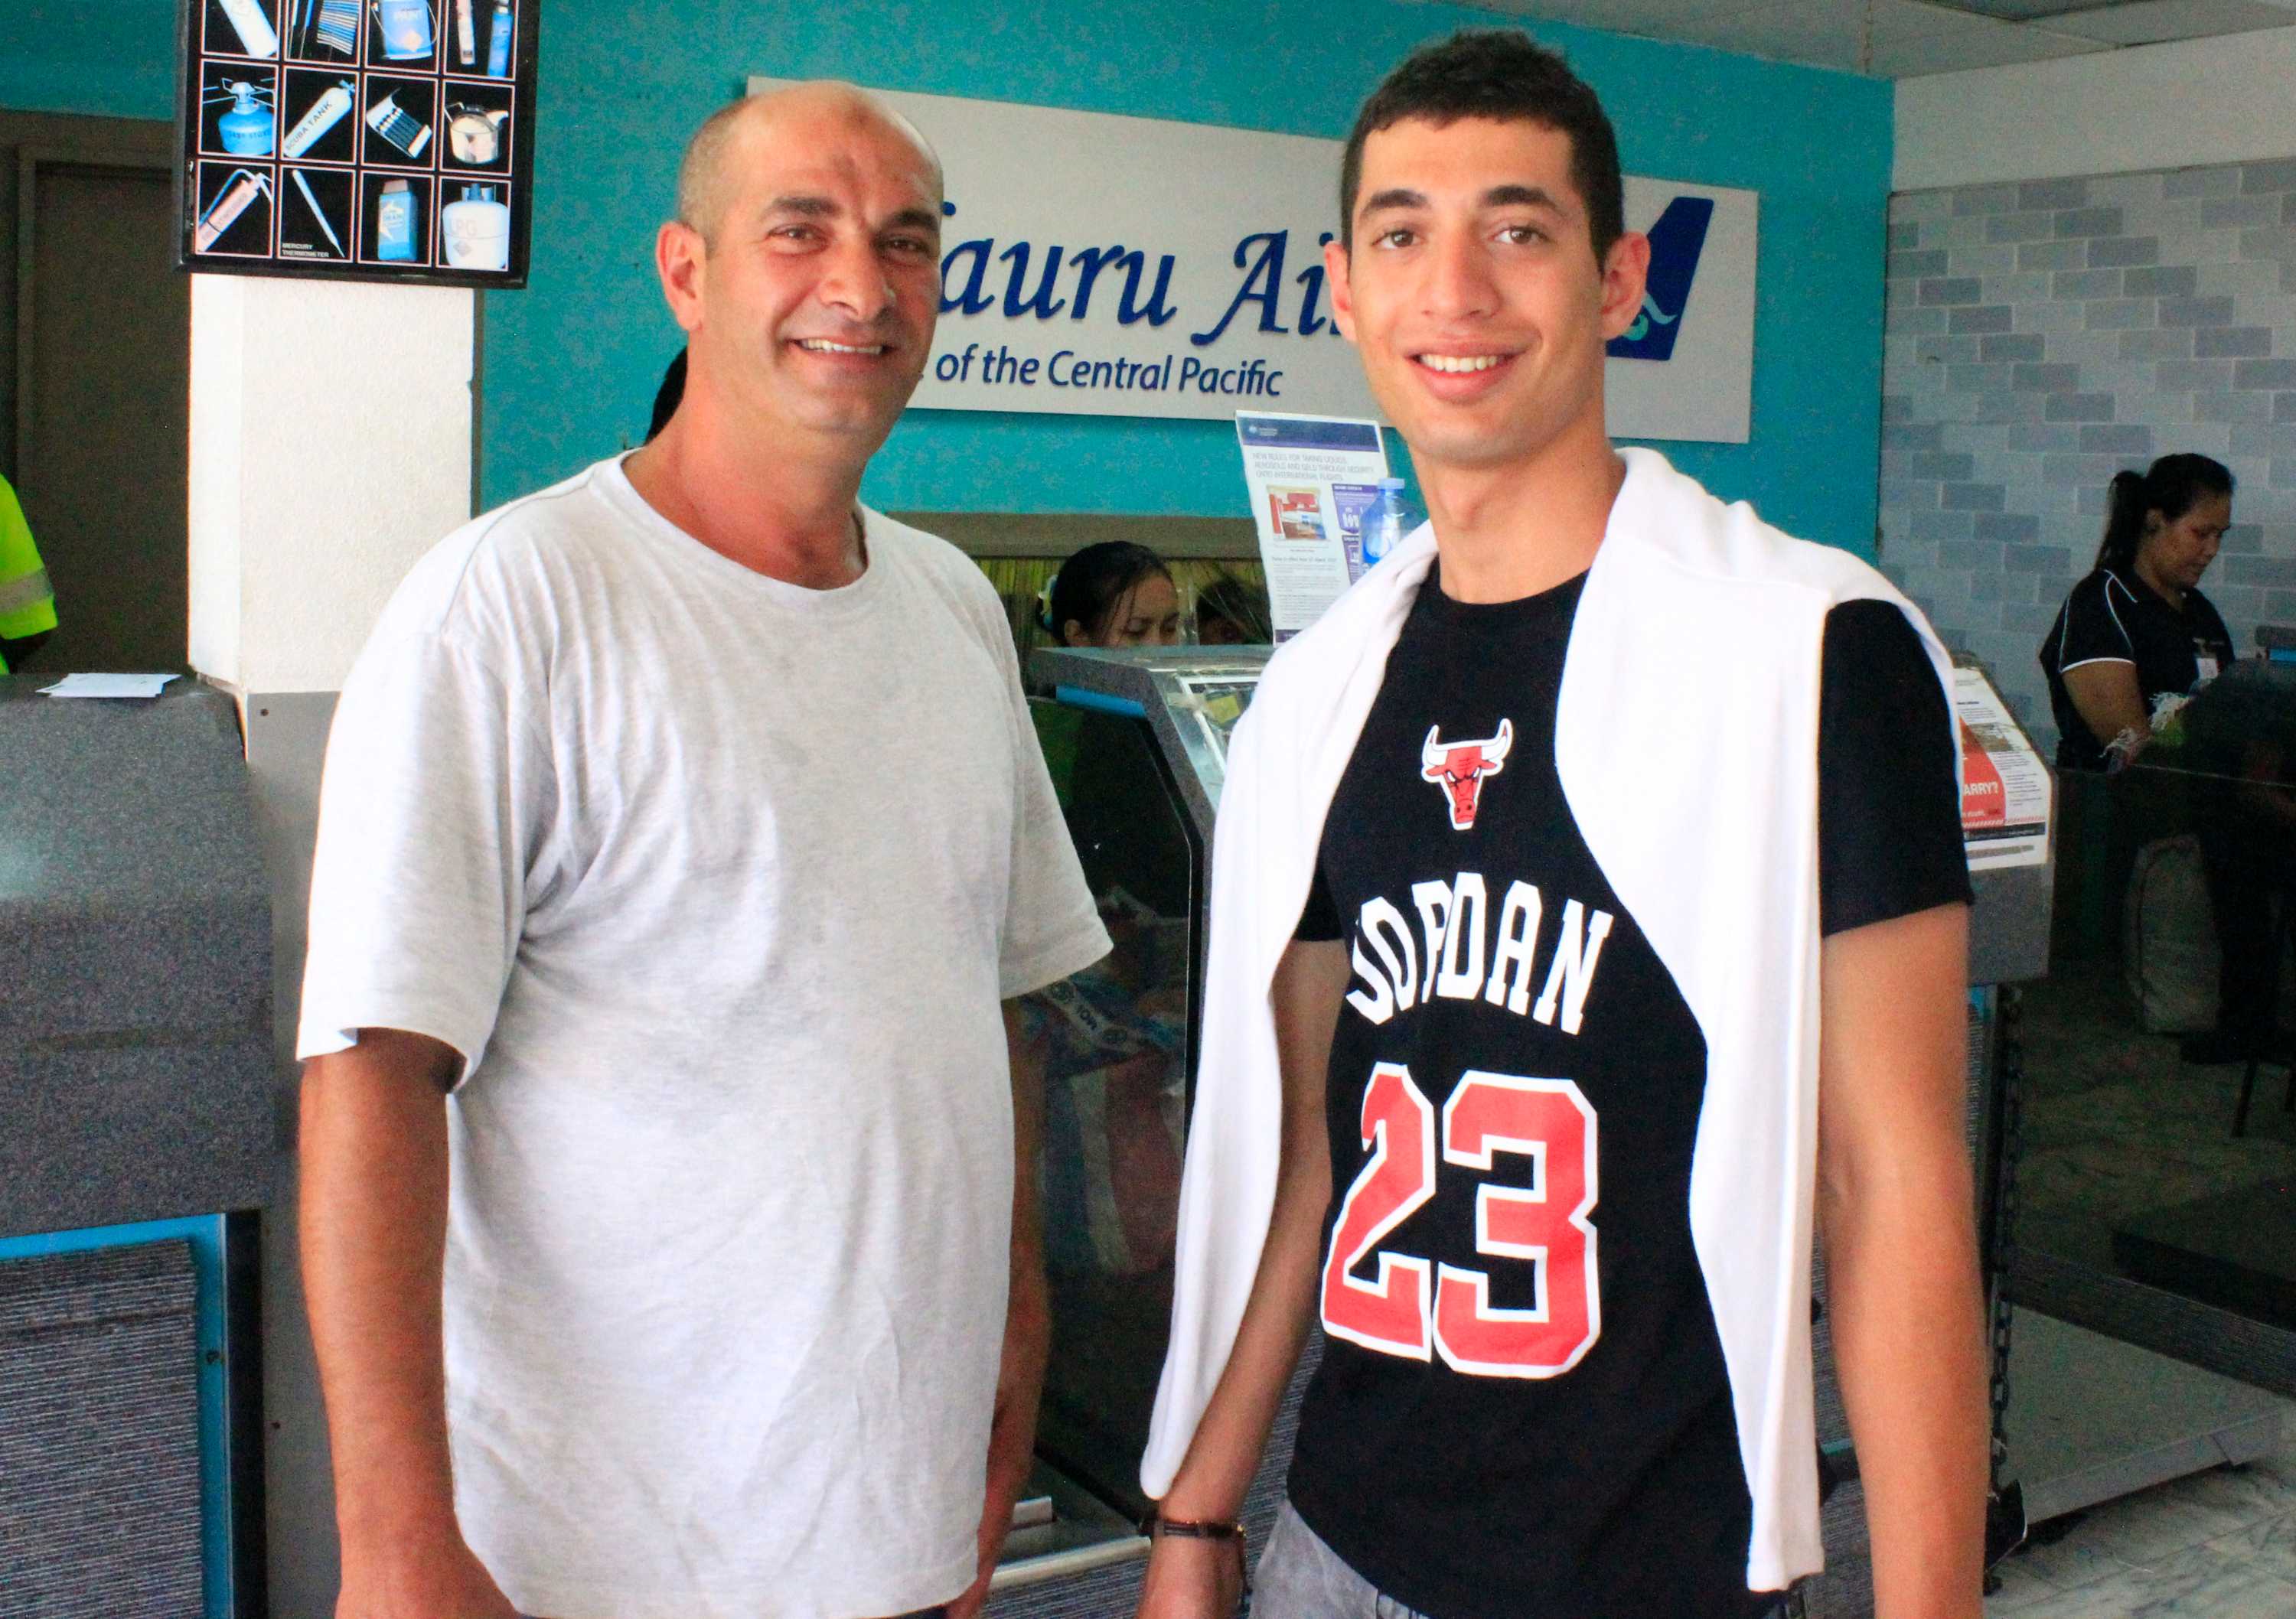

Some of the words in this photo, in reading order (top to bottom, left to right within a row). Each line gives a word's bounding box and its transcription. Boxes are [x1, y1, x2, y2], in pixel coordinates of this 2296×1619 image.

[285, 126, 308, 151] SCUBA
[309, 99, 333, 126] TANK
[282, 249, 330, 258] THERMOMETER
[939, 201, 1178, 327] auru
[1190, 230, 1342, 346] Ai
[936, 343, 979, 383] of
[983, 345, 1040, 385] the
[1049, 350, 1173, 392] Central
[1179, 357, 1283, 396] Pacific
[1963, 781, 1998, 796] ARRY?
[1345, 871, 1614, 1036] JORDAN
[1319, 1061, 1602, 1380] 23
